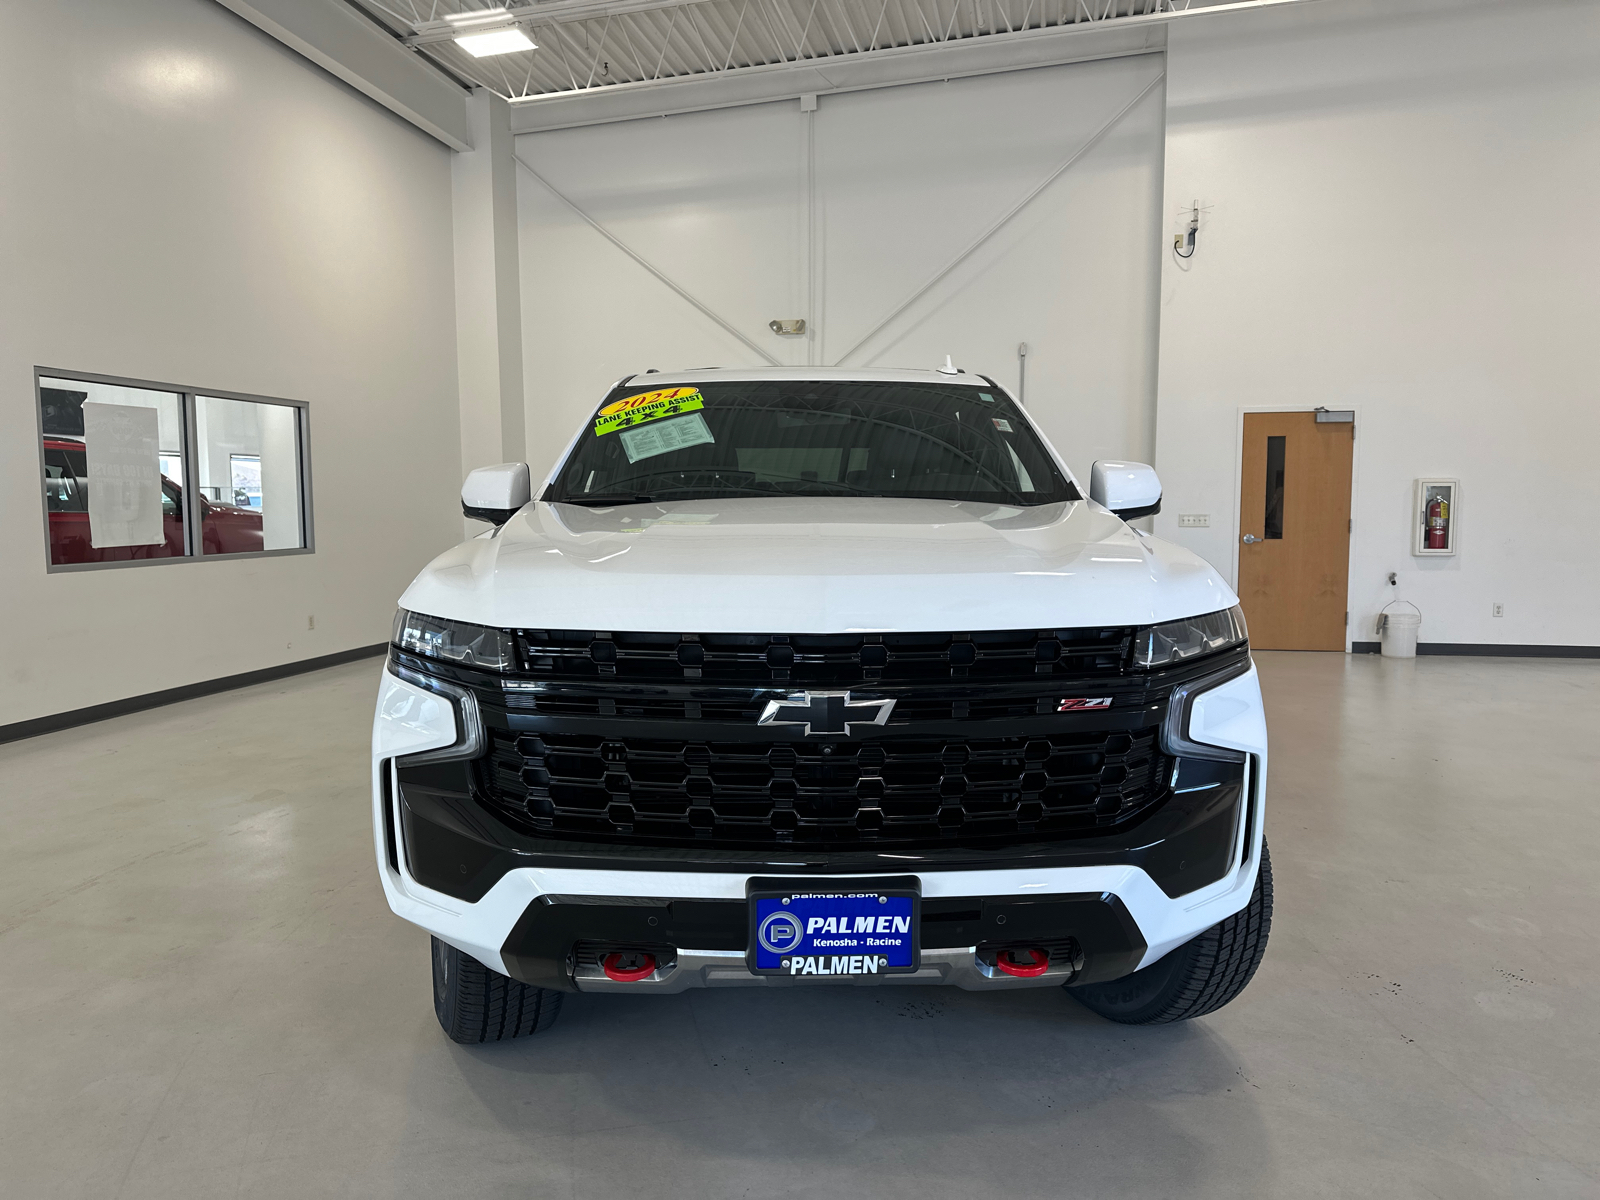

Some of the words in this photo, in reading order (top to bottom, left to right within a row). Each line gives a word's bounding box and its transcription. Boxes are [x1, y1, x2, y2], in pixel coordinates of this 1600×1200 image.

[597, 413, 622, 426] LANE
[624, 402, 666, 419] KEEPING
[668, 394, 701, 406] ASSIST
[613, 388, 681, 413] 2024
[615, 417, 635, 427] 4
[663, 405, 683, 414] 4
[1057, 697, 1113, 711] Z71
[806, 916, 911, 934] PALMEN
[813, 938, 858, 947] Kenosha
[866, 937, 902, 946] Racine
[790, 955, 879, 975] PALMEN
